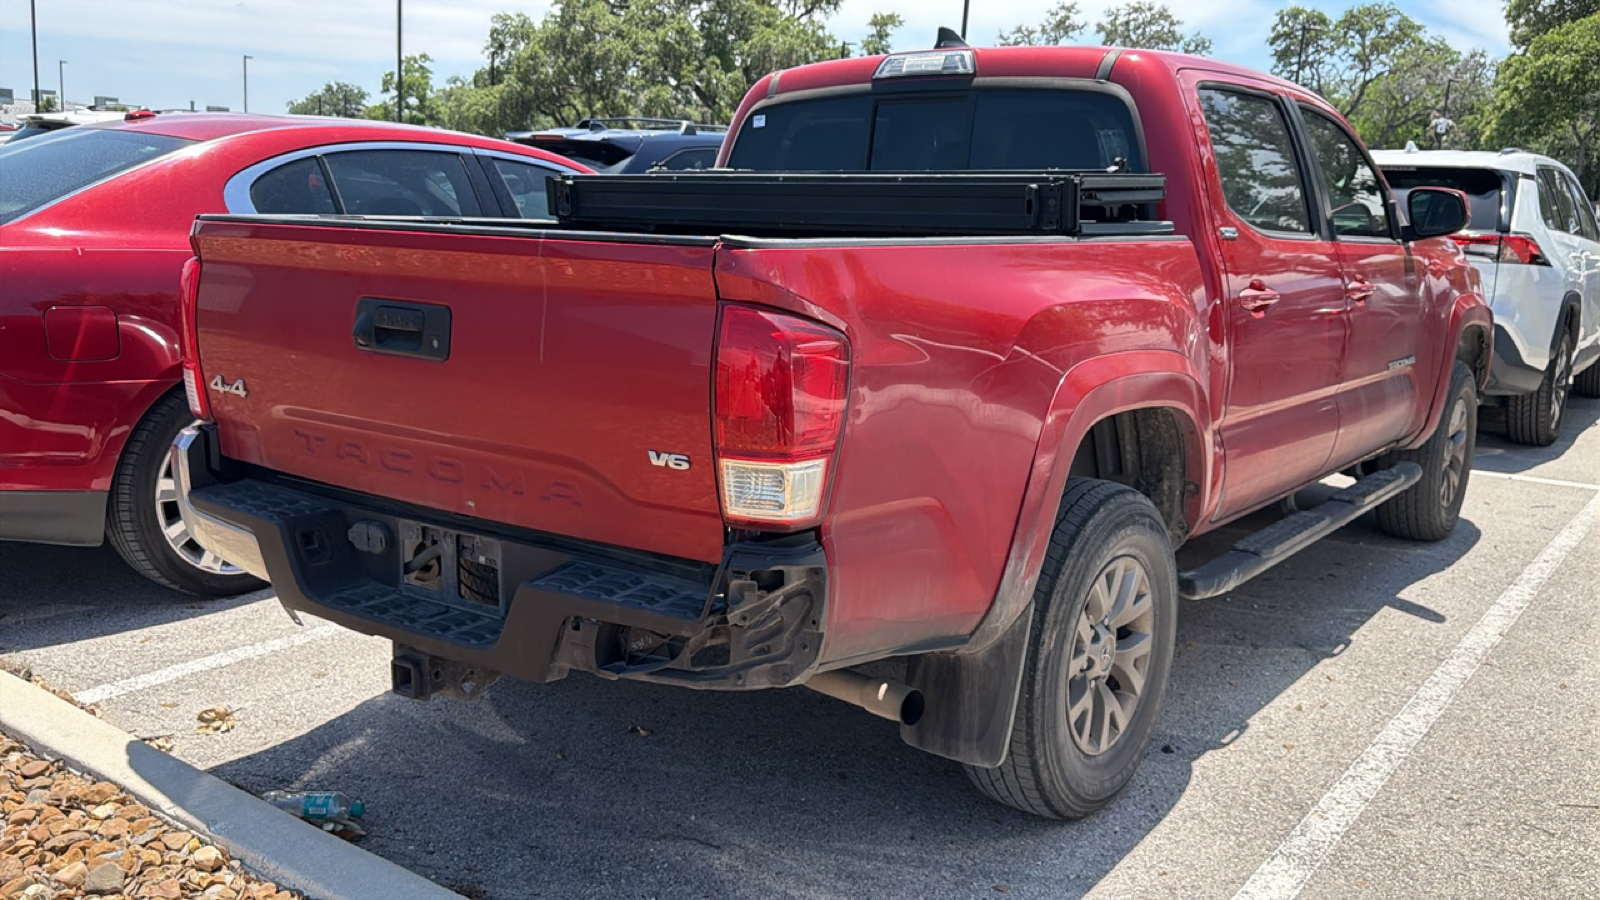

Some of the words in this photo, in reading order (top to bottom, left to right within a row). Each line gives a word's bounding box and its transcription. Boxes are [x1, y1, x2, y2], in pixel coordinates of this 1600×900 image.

[210, 374, 248, 398] 4x4
[294, 429, 583, 506] TACOMA
[647, 450, 691, 470] V6
